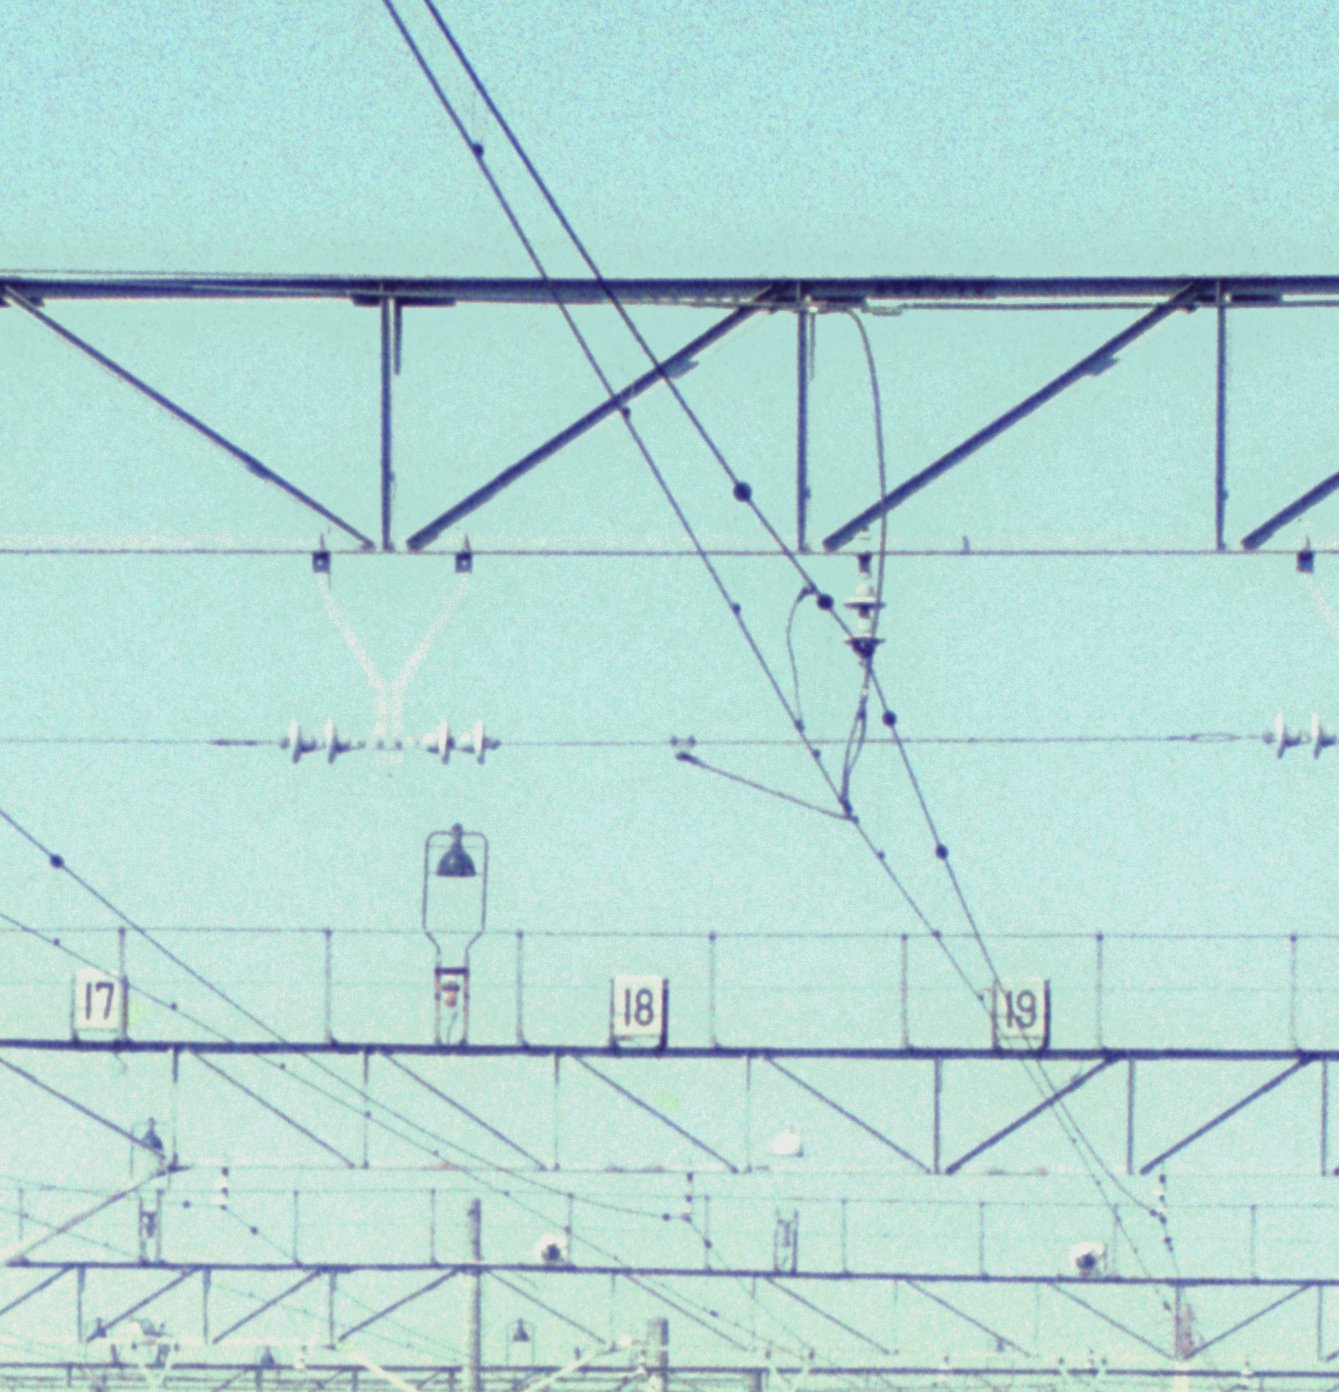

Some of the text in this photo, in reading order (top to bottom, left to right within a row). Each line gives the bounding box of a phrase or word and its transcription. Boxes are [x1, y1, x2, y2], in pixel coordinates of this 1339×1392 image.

[85, 982, 115, 1020] 17
[624, 988, 655, 1027] 18
[1005, 990, 1037, 1029] 19
